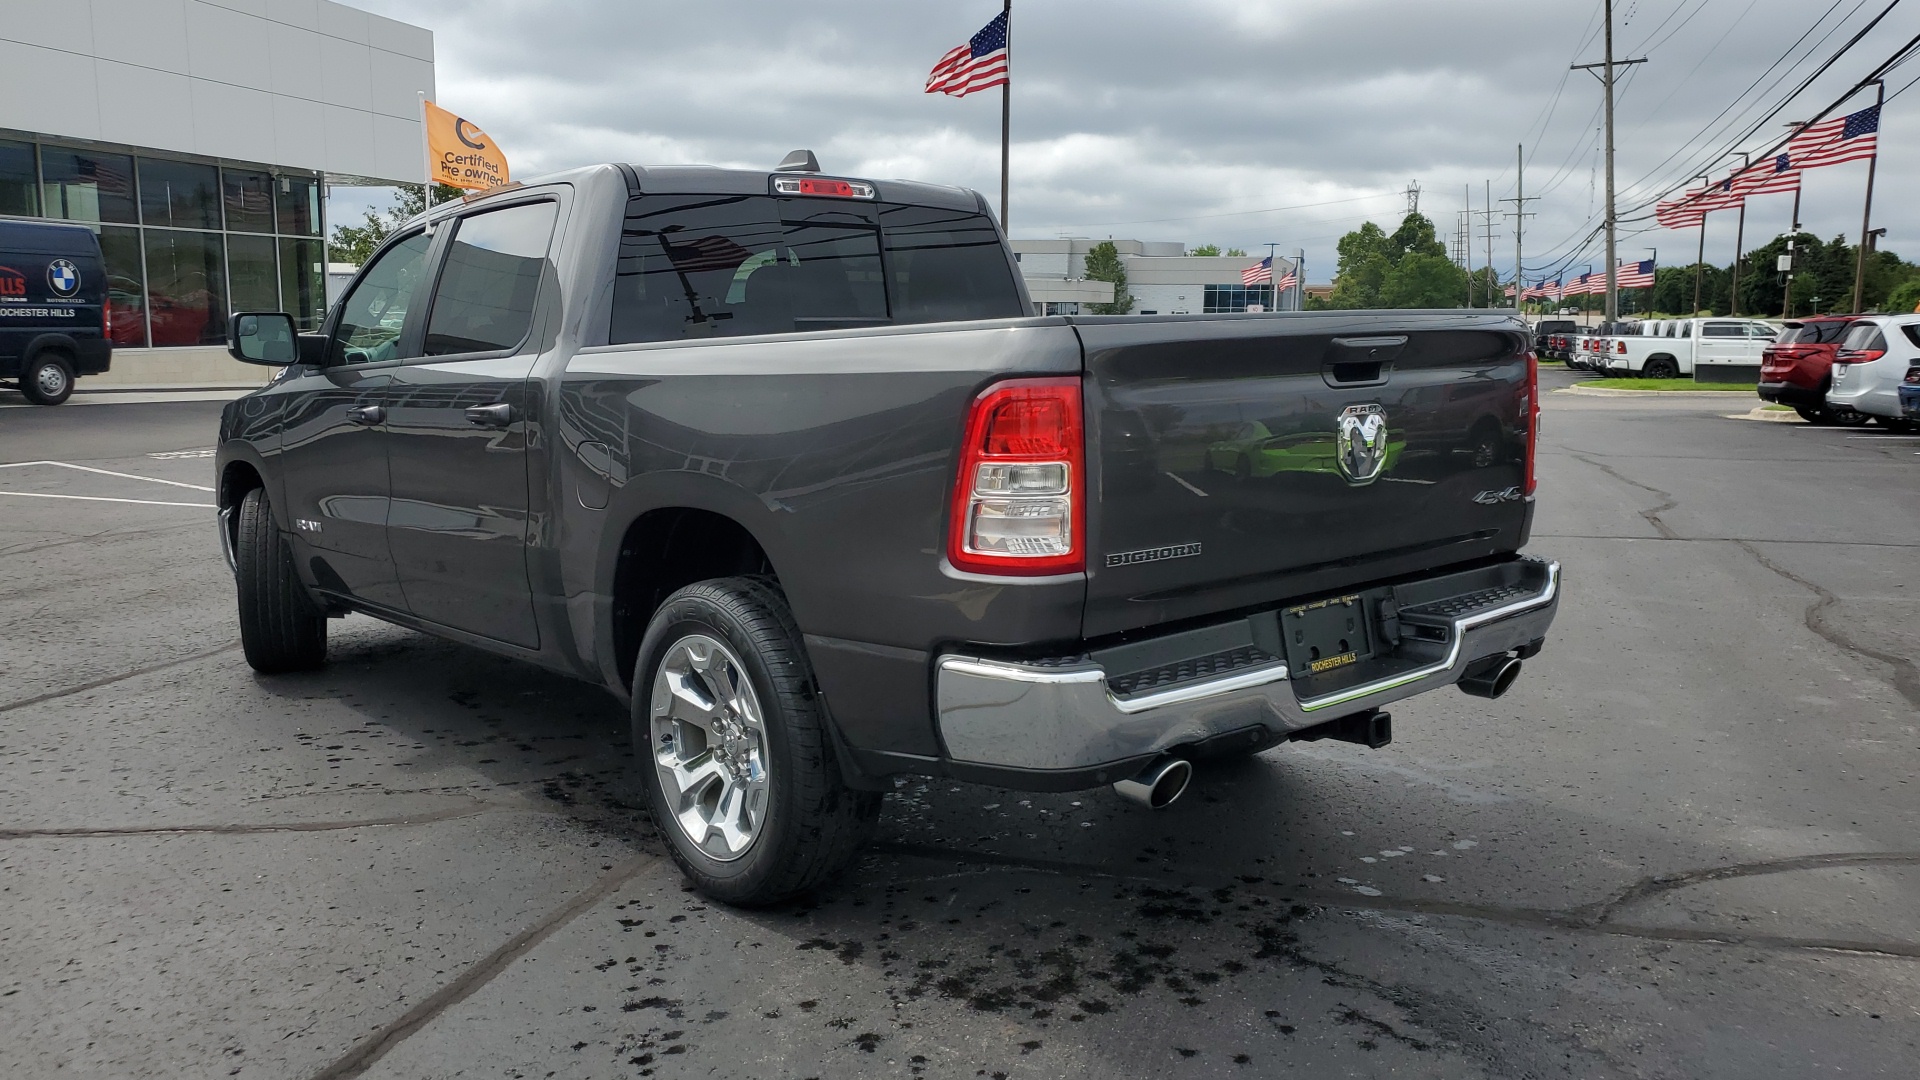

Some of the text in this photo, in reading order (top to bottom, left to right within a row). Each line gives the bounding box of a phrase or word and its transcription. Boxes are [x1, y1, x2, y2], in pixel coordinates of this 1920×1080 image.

[440, 160, 460, 176] Pre
[464, 168, 504, 186] owned
[444, 152, 498, 174] Certified
[50, 260, 76, 271] BMW
[0, 308, 75, 317] OCHESTER HILLS
[1349, 404, 1377, 414] RAM
[1105, 542, 1201, 568] BIGHORN
[1311, 652, 1357, 672] ROCHESTER HILLS
